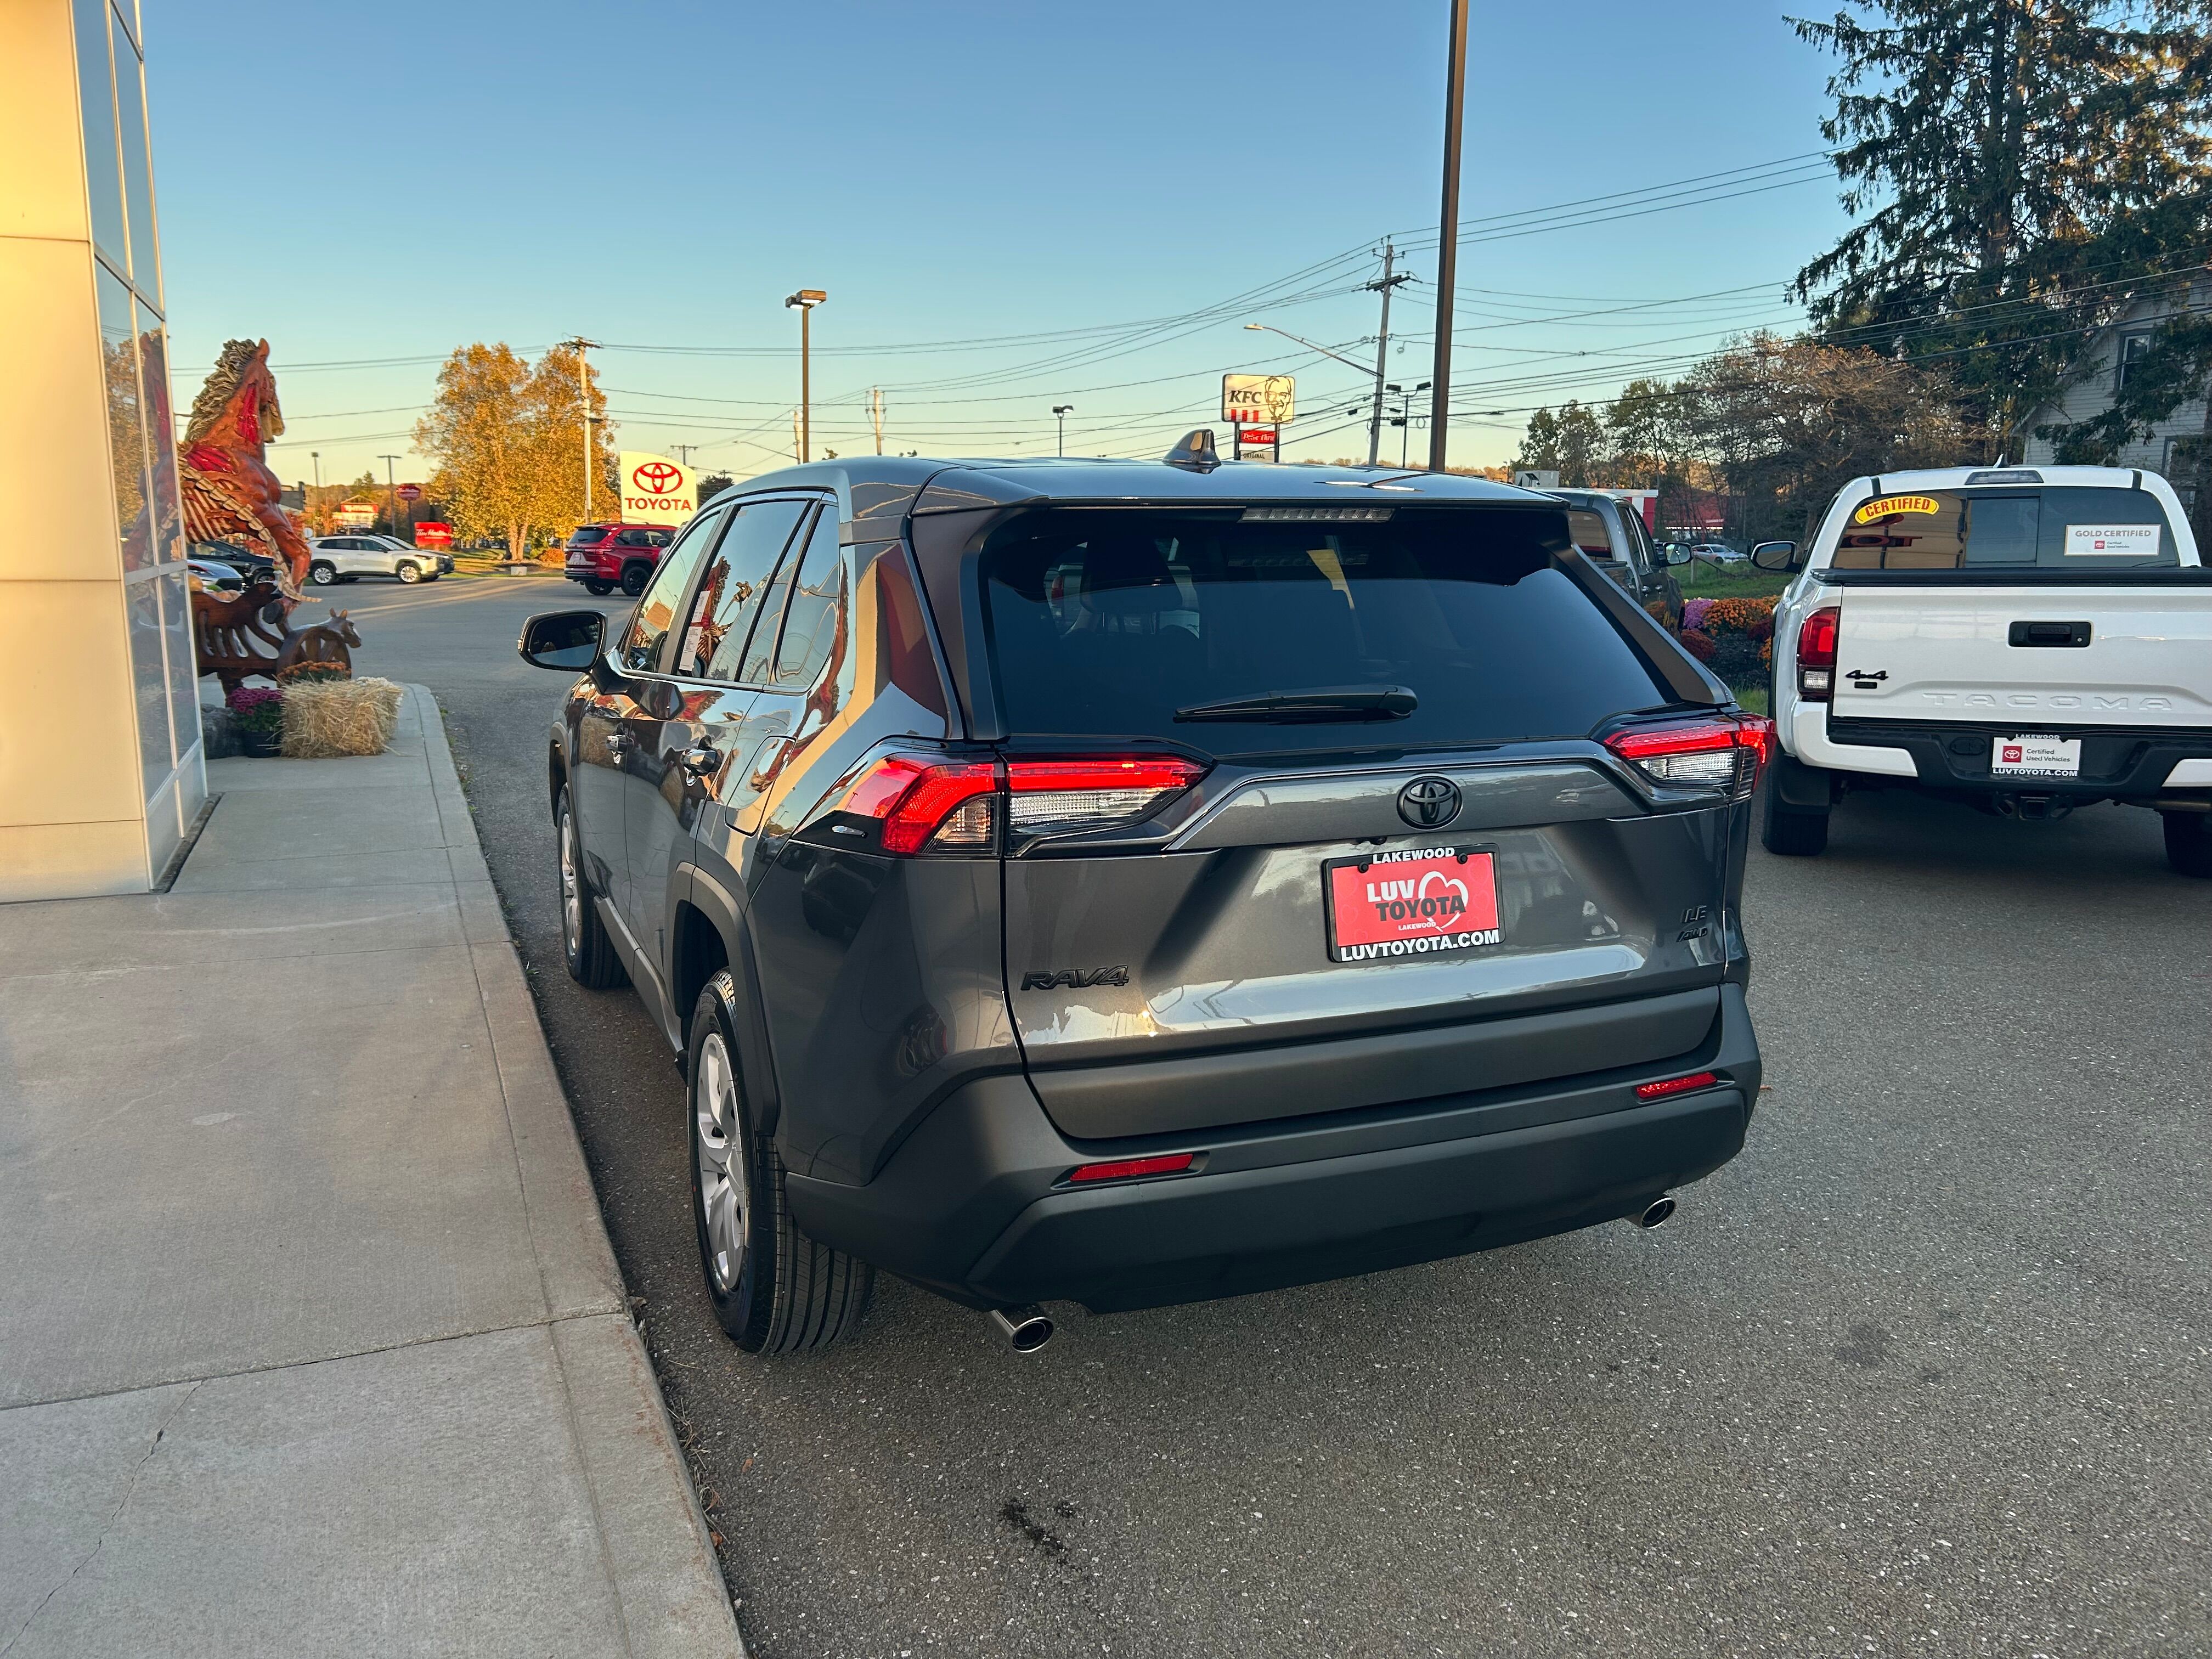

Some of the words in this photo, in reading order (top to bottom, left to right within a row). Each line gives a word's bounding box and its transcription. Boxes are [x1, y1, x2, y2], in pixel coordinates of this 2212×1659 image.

[1229, 390, 1262, 404] KFC
[624, 498, 693, 511] TOYOTA
[1865, 498, 1931, 517] CERTIFIED
[1922, 693, 2172, 710] TACOMA
[1993, 768, 2078, 777] LUVTOYOTA.COM
[1373, 847, 1455, 865] LAKEWOOD
[1367, 879, 1415, 902] LUV
[1375, 895, 1466, 922] TOYOTA
[1681, 905, 1707, 923] LE
[1398, 921, 1436, 931] LAKEWOOD
[1340, 929, 1499, 962] LUVTOYOTA.COM
[1020, 964, 1130, 991] RAV4
